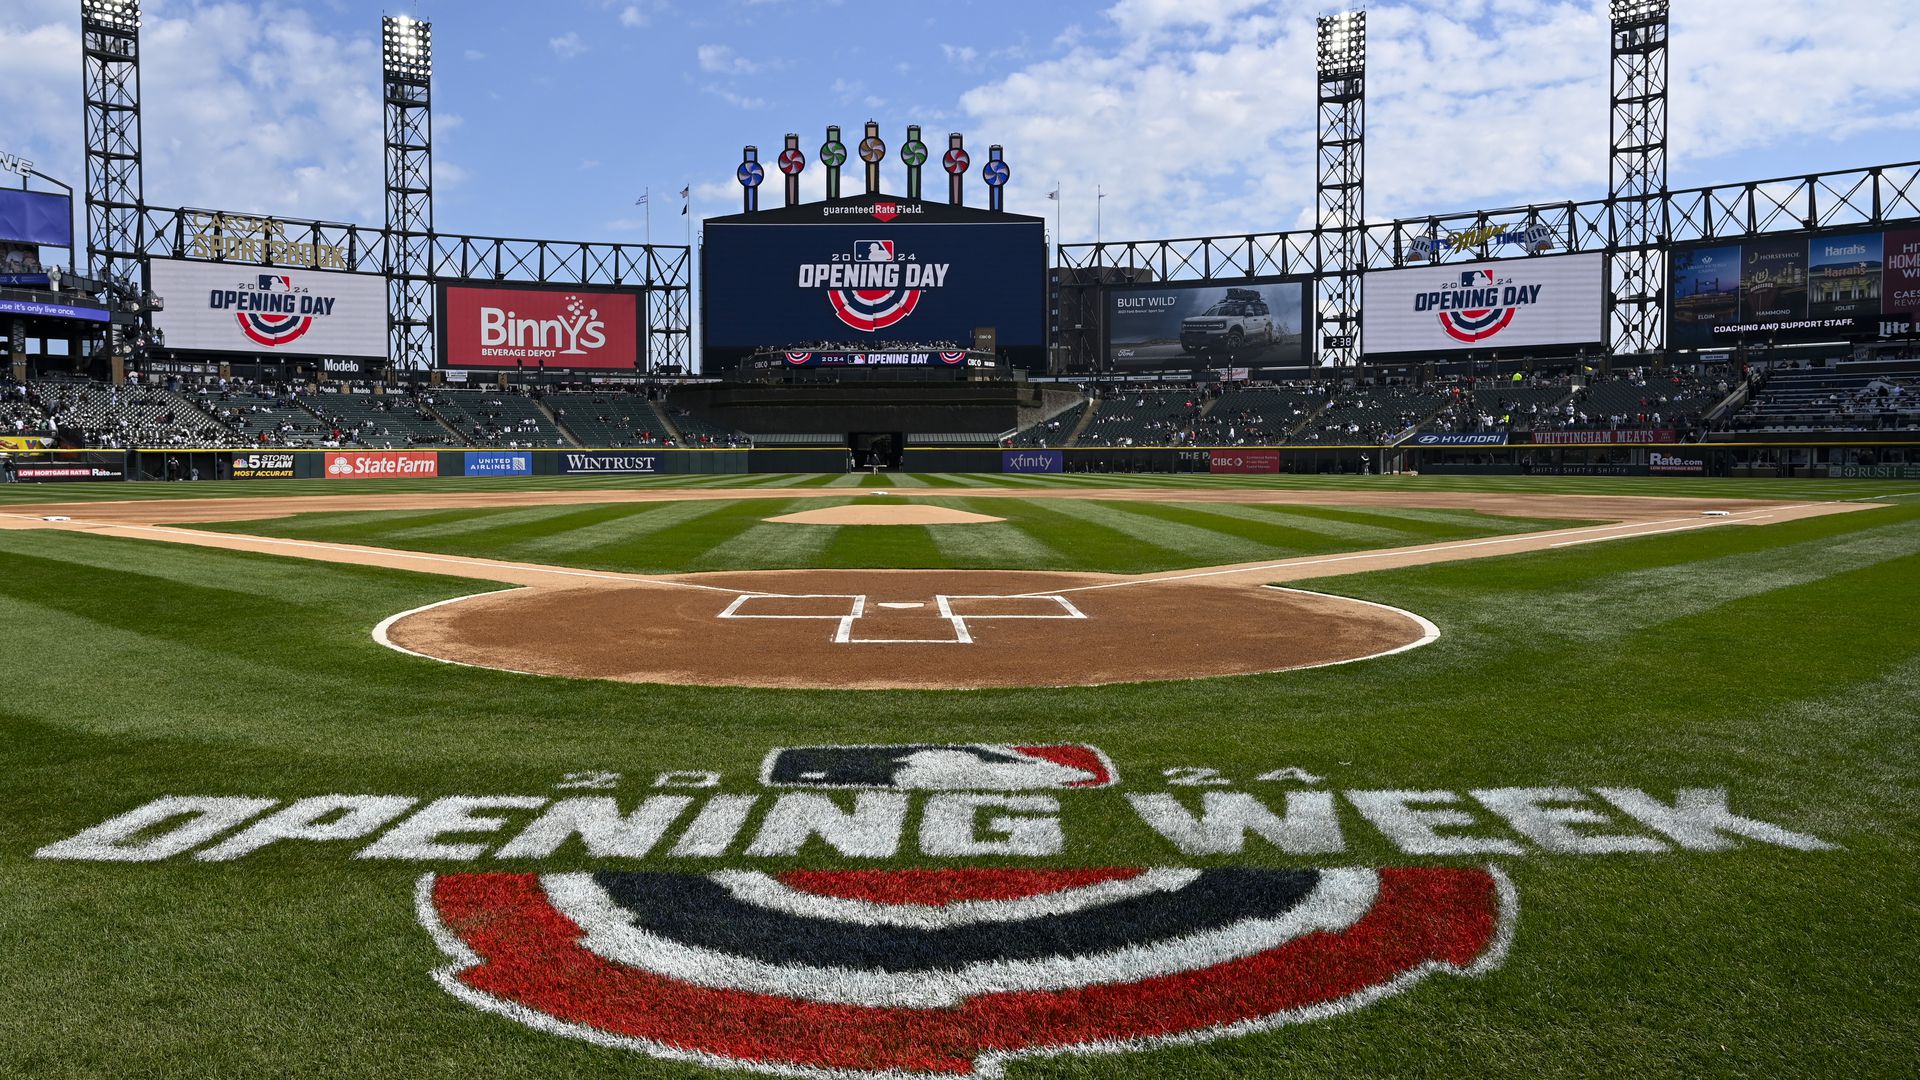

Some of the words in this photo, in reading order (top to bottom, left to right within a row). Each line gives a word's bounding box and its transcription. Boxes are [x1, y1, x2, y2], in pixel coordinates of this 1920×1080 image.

[823, 204, 874, 216] guaranteed
[875, 204, 895, 214] Rate
[193, 213, 285, 236] CAESARS
[1448, 223, 1510, 255] Miller
[1496, 231, 1526, 244] TIME
[1527, 226, 1549, 244] Lite
[193, 233, 346, 271] SPORTSBOOK
[1412, 240, 1430, 253] Lite
[831, 253, 851, 261] 20
[897, 253, 917, 261] 24
[799, 263, 900, 288] OPENING
[905, 263, 950, 288] DAY
[210, 289, 296, 314] OPENING
[300, 295, 336, 316] DAY
[1117, 297, 1146, 307] BUILT
[1148, 296, 1175, 306] WILD
[1414, 287, 1498, 312] OPENING
[1503, 284, 1542, 306] DAY
[14, 303, 26, 311] it's
[27, 305, 43, 314] only
[57, 308, 75, 316] once.
[1756, 308, 1791, 317] HAMMOND
[1834, 304, 1856, 312] JOLIET
[1713, 324, 1758, 333] COACHING
[1760, 322, 1779, 332] AND
[1780, 320, 1823, 330] SUPPORT
[1824, 318, 1855, 328] STAFF.
[1878, 321, 1910, 338] Lite
[1331, 337, 1351, 347] 2:38
[481, 348, 526, 357] BEVERAGE
[528, 349, 556, 358] DEPOT
[868, 353, 908, 365] OPENING
[911, 353, 929, 364] DAY
[1117, 348, 1135, 357] Ford
[324, 358, 359, 373] Modelo
[353, 386, 371, 395] Modelo
[386, 387, 404, 395] Modelo
[1441, 435, 1500, 443] HYUNDAI
[1535, 431, 1611, 444] WHITTINGHAM
[1617, 430, 1654, 443] MEATS
[249, 454, 260, 469] 5
[567, 454, 655, 470] WINTRUST
[1010, 454, 1052, 471] xfinity
[1179, 452, 1200, 460] THE
[1212, 457, 1233, 466] CIBC
[1650, 452, 1703, 465] Rate.com
[260, 461, 293, 469] TEAM
[92, 468, 122, 477] Rate.com
[1859, 466, 1897, 478] RUSH
[553, 770, 721, 790] 20
[1162, 767, 1326, 786] 24
[34, 794, 1066, 863] OPENING
[1122, 786, 1848, 857] WEEK
